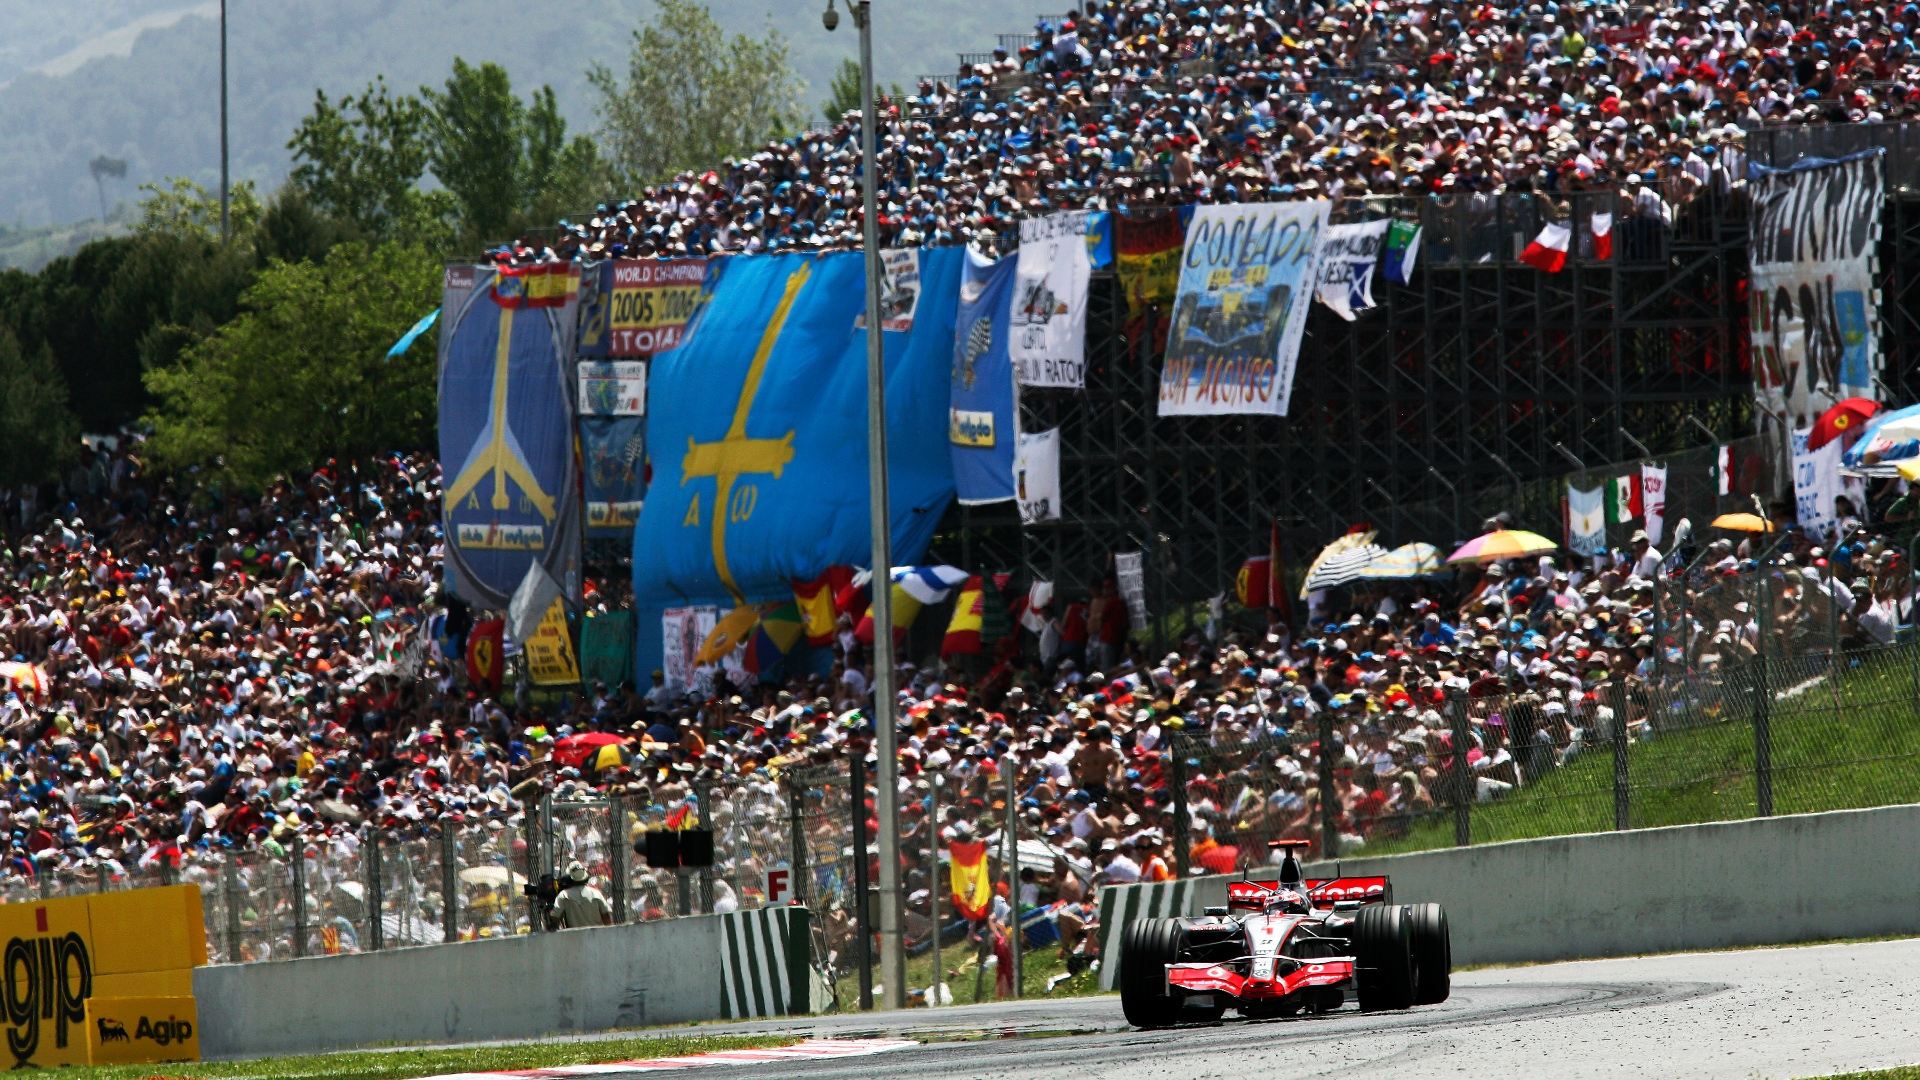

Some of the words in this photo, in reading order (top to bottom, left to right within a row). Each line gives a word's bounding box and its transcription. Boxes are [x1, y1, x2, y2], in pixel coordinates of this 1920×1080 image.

[1186, 212, 1320, 269] COSLADA
[614, 267, 651, 284] WORLD
[654, 264, 706, 282] CHAMPION
[612, 290, 654, 324] 2005
[1045, 359, 1084, 388] RATO!
[768, 870, 789, 902] F
[0, 906, 92, 1061] gip
[135, 1014, 192, 1047] Agip
